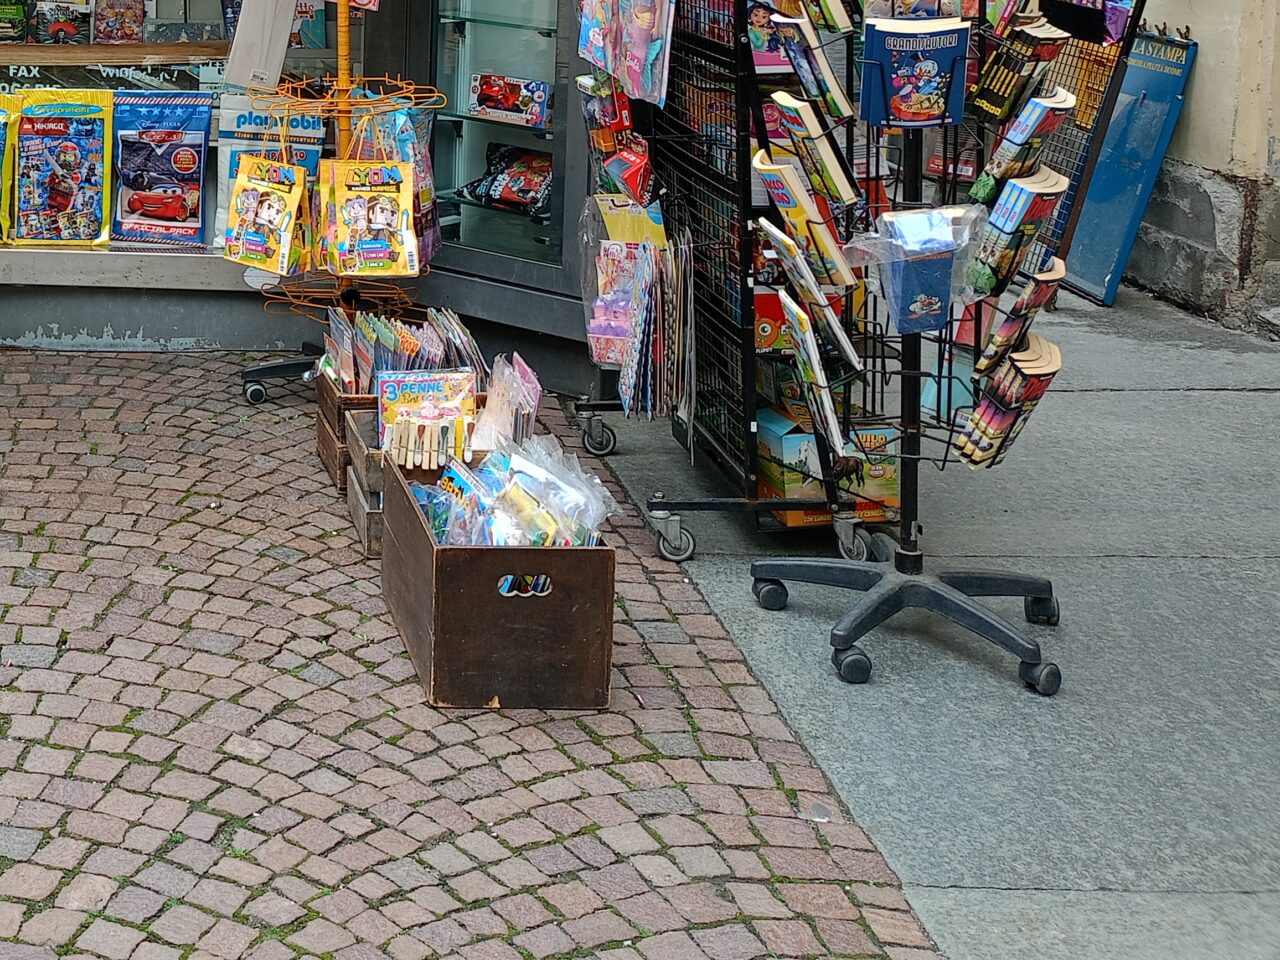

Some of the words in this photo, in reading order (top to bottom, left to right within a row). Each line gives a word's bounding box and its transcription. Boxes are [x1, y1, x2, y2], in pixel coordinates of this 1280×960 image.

[1131, 38, 1145, 55] LA
[1146, 40, 1187, 64] STAMPA
[9, 65, 40, 77] FAX
[34, 122, 65, 131] NINJAGO
[248, 162, 296, 185] LYON
[345, 166, 403, 186] LYON
[122, 223, 166, 234] OFFICIAL
[166, 226, 196, 236] PACK
[384, 383, 398, 401] 3
[400, 382, 444, 394] PENNE
